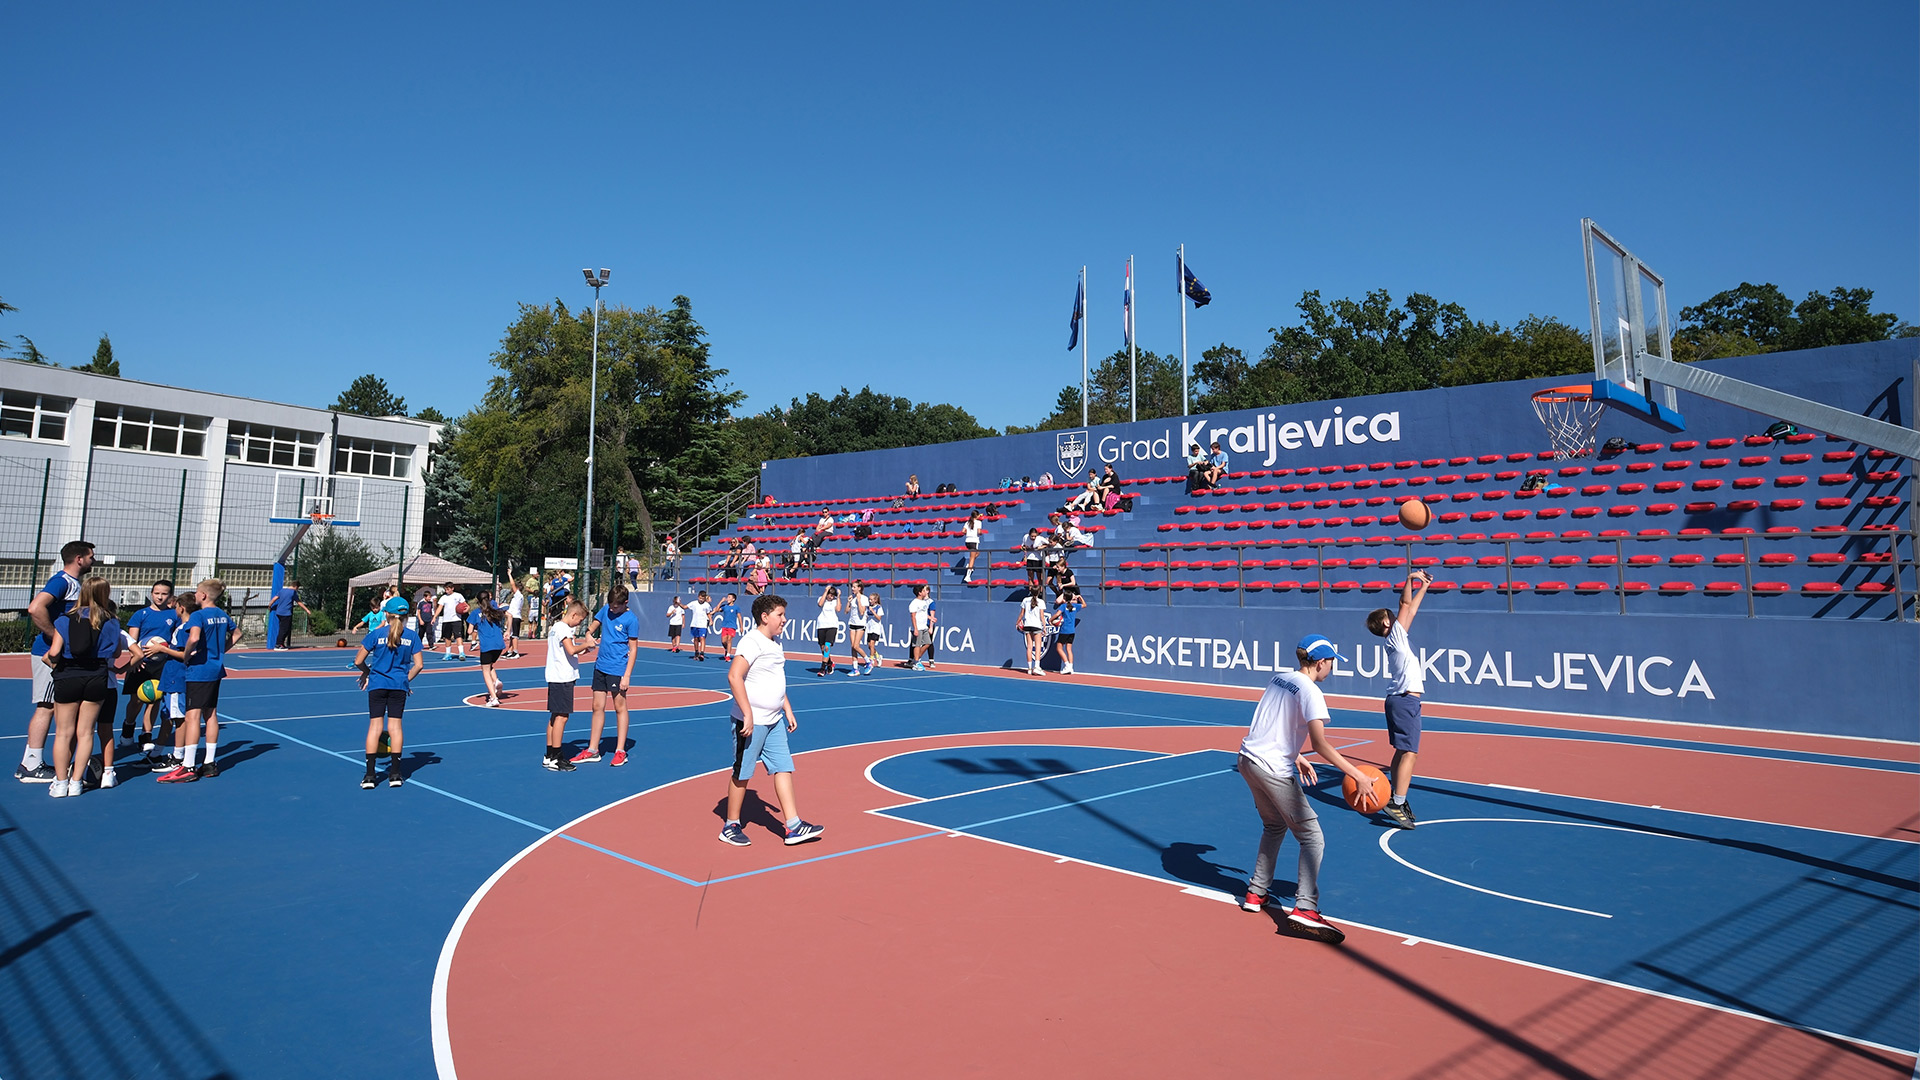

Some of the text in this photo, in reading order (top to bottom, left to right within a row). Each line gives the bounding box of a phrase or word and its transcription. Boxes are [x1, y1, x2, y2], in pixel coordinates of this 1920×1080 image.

[1098, 406, 1401, 467] Grad Kraljevica
[800, 619, 846, 644] KLB
[1106, 633, 1716, 700] BASKETBALL LU KRALJEVICA
